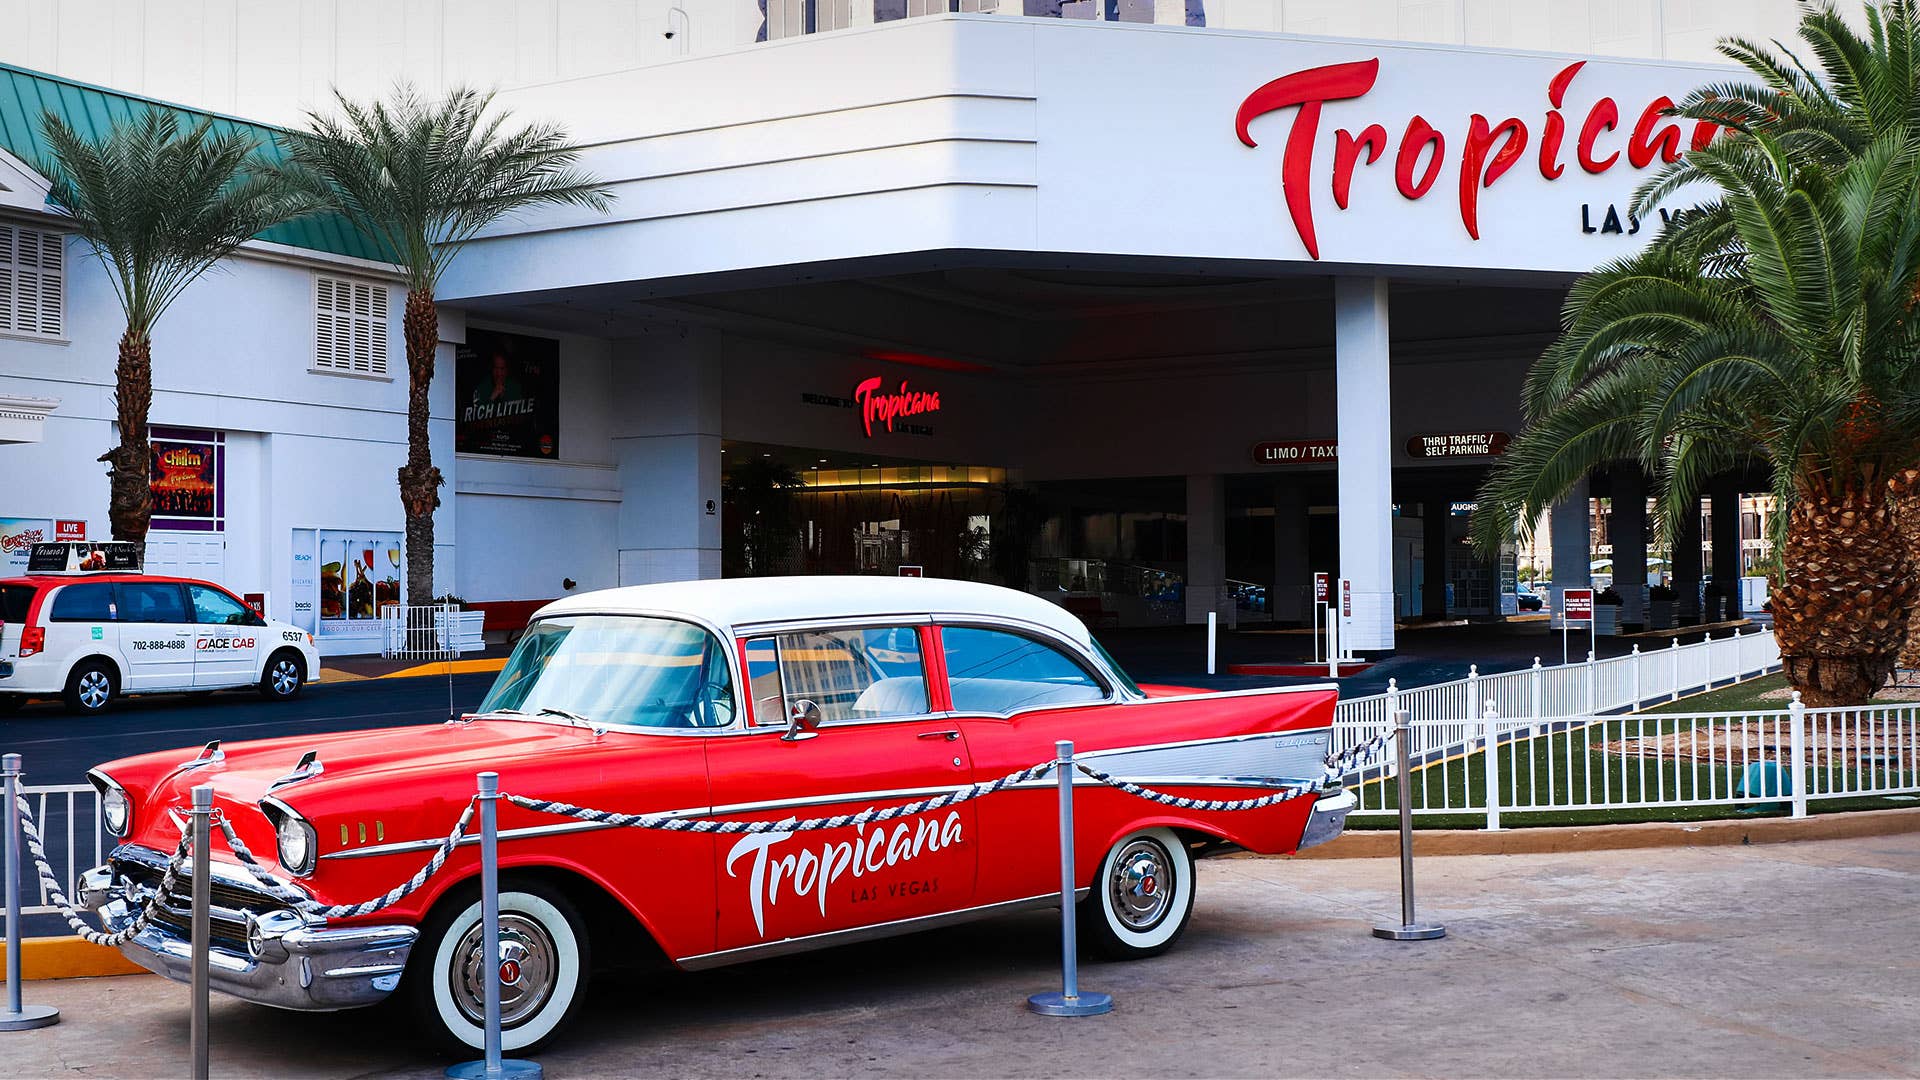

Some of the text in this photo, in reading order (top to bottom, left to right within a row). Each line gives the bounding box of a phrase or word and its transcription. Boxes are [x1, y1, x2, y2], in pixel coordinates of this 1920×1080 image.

[1581, 203, 1641, 235] LAS
[464, 398, 535, 422] RICH LITTLE
[855, 376, 940, 437] Tropicana
[1422, 434, 1494, 446] THRU TRAFFIC /
[1265, 447, 1298, 460] LIMO
[1301, 446, 1307, 459] /
[1425, 444, 1489, 456] SELF PARKING
[63, 523, 78, 533] LIVE
[282, 631, 303, 642] 6537
[133, 640, 186, 650] 702-888-4888
[208, 638, 255, 649] ACE CAB
[726, 807, 963, 938] Tropicana
[851, 878, 940, 904] LAS VEGAS
